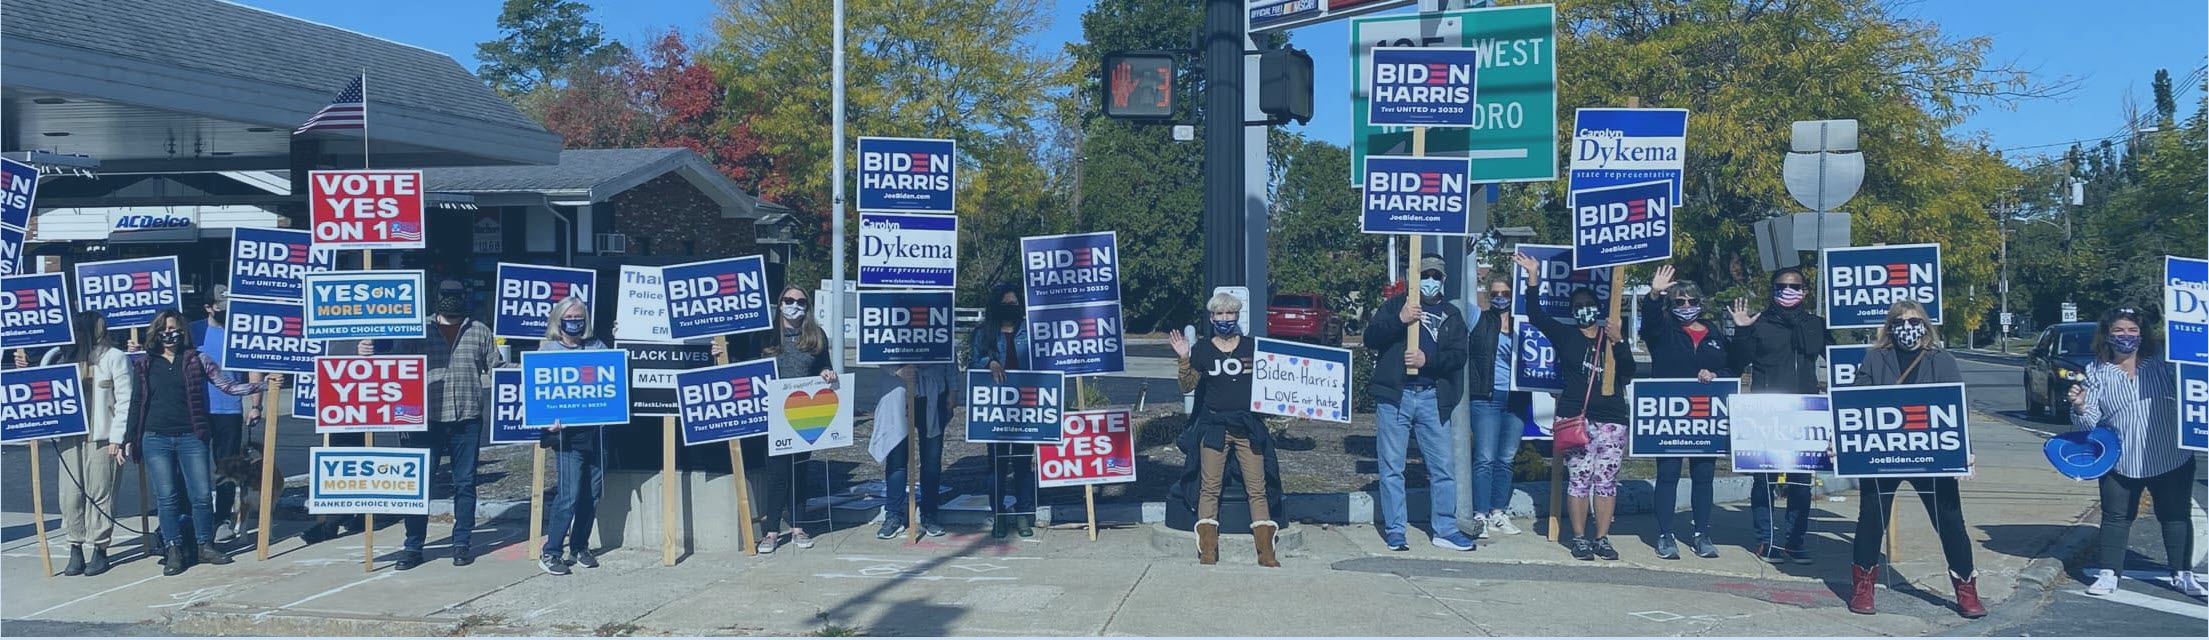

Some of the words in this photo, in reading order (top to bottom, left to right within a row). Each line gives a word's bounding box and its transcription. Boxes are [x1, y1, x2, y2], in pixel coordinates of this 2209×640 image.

[1474, 38, 1543, 68] WEST
[1377, 63, 1470, 84] BIDEN
[1155, 67, 1170, 107] 3
[1375, 86, 1470, 104] HARRIS
[1580, 128, 1624, 139] Carolyn
[863, 152, 949, 172] BIDEN
[1578, 138, 1677, 168] Dykema
[864, 174, 950, 191] HARRIS
[1370, 171, 1463, 193] BIDEN
[1576, 170, 1600, 178] state
[1604, 171, 1676, 180] representative
[316, 175, 416, 196] VOTE
[326, 198, 400, 219] YES
[1369, 194, 1462, 212] HARRIS
[1580, 197, 1666, 227] BIDEN
[116, 215, 191, 228] ACDelco
[862, 218, 900, 233] Carolyn
[1389, 214, 1441, 222] JoeBiden.com
[316, 221, 364, 240] ON
[373, 221, 388, 240] 1
[1580, 219, 1667, 246] HARRIS
[238, 240, 329, 265] BIDEN
[862, 235, 953, 264] Dykema
[1600, 242, 1648, 254] JoeBiden.com
[1027, 246, 1112, 270] BIDEN
[236, 260, 327, 280] HARR
[624, 270, 662, 285] Tha
[888, 267, 952, 275] representative
[1029, 267, 1113, 287] HARRIS
[1521, 260, 1612, 282] IDEN
[1833, 263, 1934, 288] BIDEN
[83, 271, 173, 294] BIDEN
[256, 280, 288, 288] UNITED
[503, 278, 589, 303] BIDEN
[668, 271, 758, 301] BIDEN
[1049, 287, 1079, 295] UNITED
[2171, 277, 2208, 290] Carol
[1, 288, 61, 311] DEN
[84, 293, 175, 311] HARRIS
[314, 284, 370, 302] YES
[371, 287, 396, 299] ON
[397, 283, 413, 301] 2
[628, 289, 664, 300] Police
[1833, 286, 1935, 307] HARRIS
[106, 308, 156, 318] JoeBiden.com
[317, 303, 363, 317] MORE
[366, 303, 413, 315] VOICE
[501, 299, 559, 317] HAR
[633, 307, 656, 317] Fire
[671, 292, 763, 319] HARRIS
[1856, 308, 1888, 317] JoeBide
[1, 307, 64, 328] RRIS
[232, 313, 303, 336] BIDE
[679, 320, 694, 328] Text
[694, 315, 726, 326] UNITED
[734, 311, 759, 321] 30330
[863, 306, 949, 327] BIDEN
[308, 326, 349, 335] RANKED
[350, 325, 386, 333] CHOICE
[387, 324, 424, 333] VOTING
[863, 327, 949, 344] HARRIS
[1033, 318, 1116, 340] BIDEN
[2174, 324, 2203, 333] state
[230, 334, 322, 353] HARRIS
[882, 345, 930, 354] JoeBiden.com
[1034, 338, 1119, 358] HARRIS
[250, 353, 282, 361] UNITED
[671, 350, 709, 361] LIVES
[1054, 357, 1101, 366] JoeBiden.com
[321, 360, 419, 380] VOTE
[534, 365, 616, 385] BIDEN
[638, 373, 675, 384] MATT
[1523, 368, 1558, 379] State
[1, 378, 75, 404] IDEN
[331, 382, 403, 403] YES
[535, 384, 617, 400] HARRIS
[682, 374, 771, 406] BIDEN
[972, 385, 1057, 407] BIDEN
[1264, 386, 1299, 404] LOVE
[1315, 394, 1339, 409] hate
[1, 399, 78, 421] ARRIS
[320, 405, 367, 424] ON
[376, 404, 390, 423] 1
[686, 395, 769, 423] HARRIS
[972, 406, 1058, 424] HARRIS
[1637, 395, 1729, 417] BIDEN
[5, 420, 59, 430] JoeBiden.com
[709, 421, 739, 430] UNITED
[748, 415, 768, 424] 3033
[1061, 413, 1126, 435] OTE
[1637, 418, 1730, 436] HARRIS
[1838, 404, 1958, 431] BIDEN
[991, 425, 1039, 434] JoeBiden.com
[775, 439, 792, 448] OUT
[1056, 435, 1113, 457] YES
[1840, 431, 1961, 453] HARRIS
[323, 460, 375, 477] YES
[377, 464, 401, 475] ON
[403, 462, 417, 478] 2
[1042, 459, 1083, 479] ON
[1091, 457, 1104, 475] 1
[1869, 455, 1935, 464] JoeBiden.com
[324, 480, 368, 491] MORE
[371, 479, 417, 491] VOICE
[355, 500, 389, 508] CHOICE
[391, 500, 424, 508] VOTING
